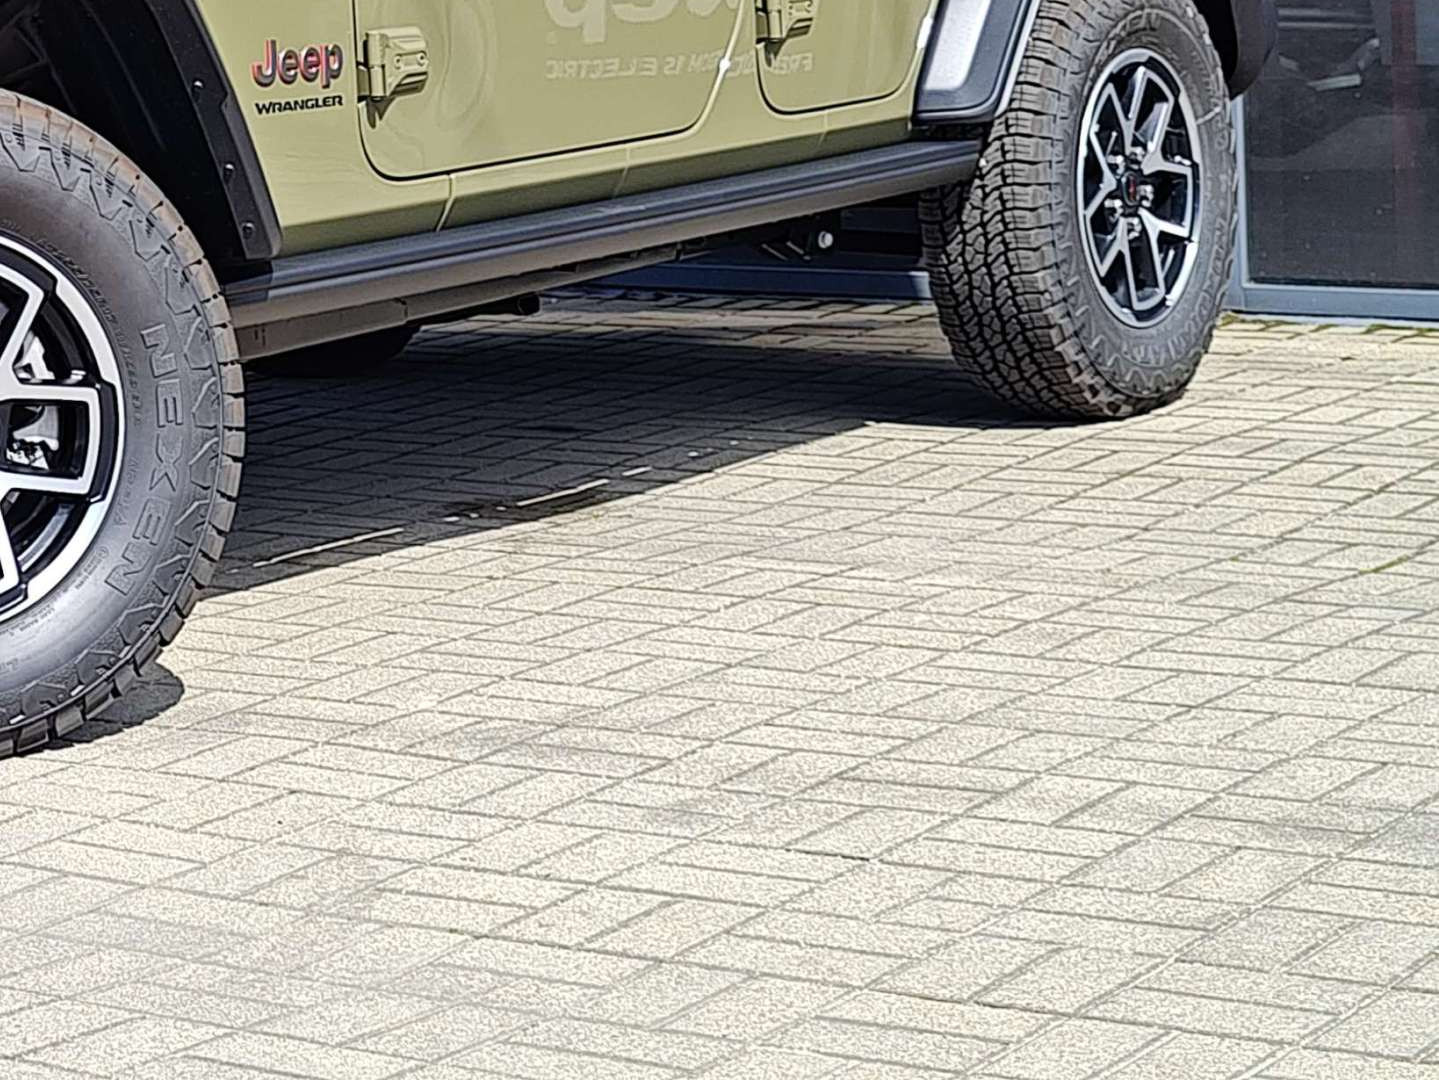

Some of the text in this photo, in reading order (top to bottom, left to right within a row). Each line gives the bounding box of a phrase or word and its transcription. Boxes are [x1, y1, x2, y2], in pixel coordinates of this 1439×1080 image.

[252, 39, 343, 89] Jeep
[254, 94, 344, 115] WRANGLER
[105, 322, 184, 596] NEXEN
